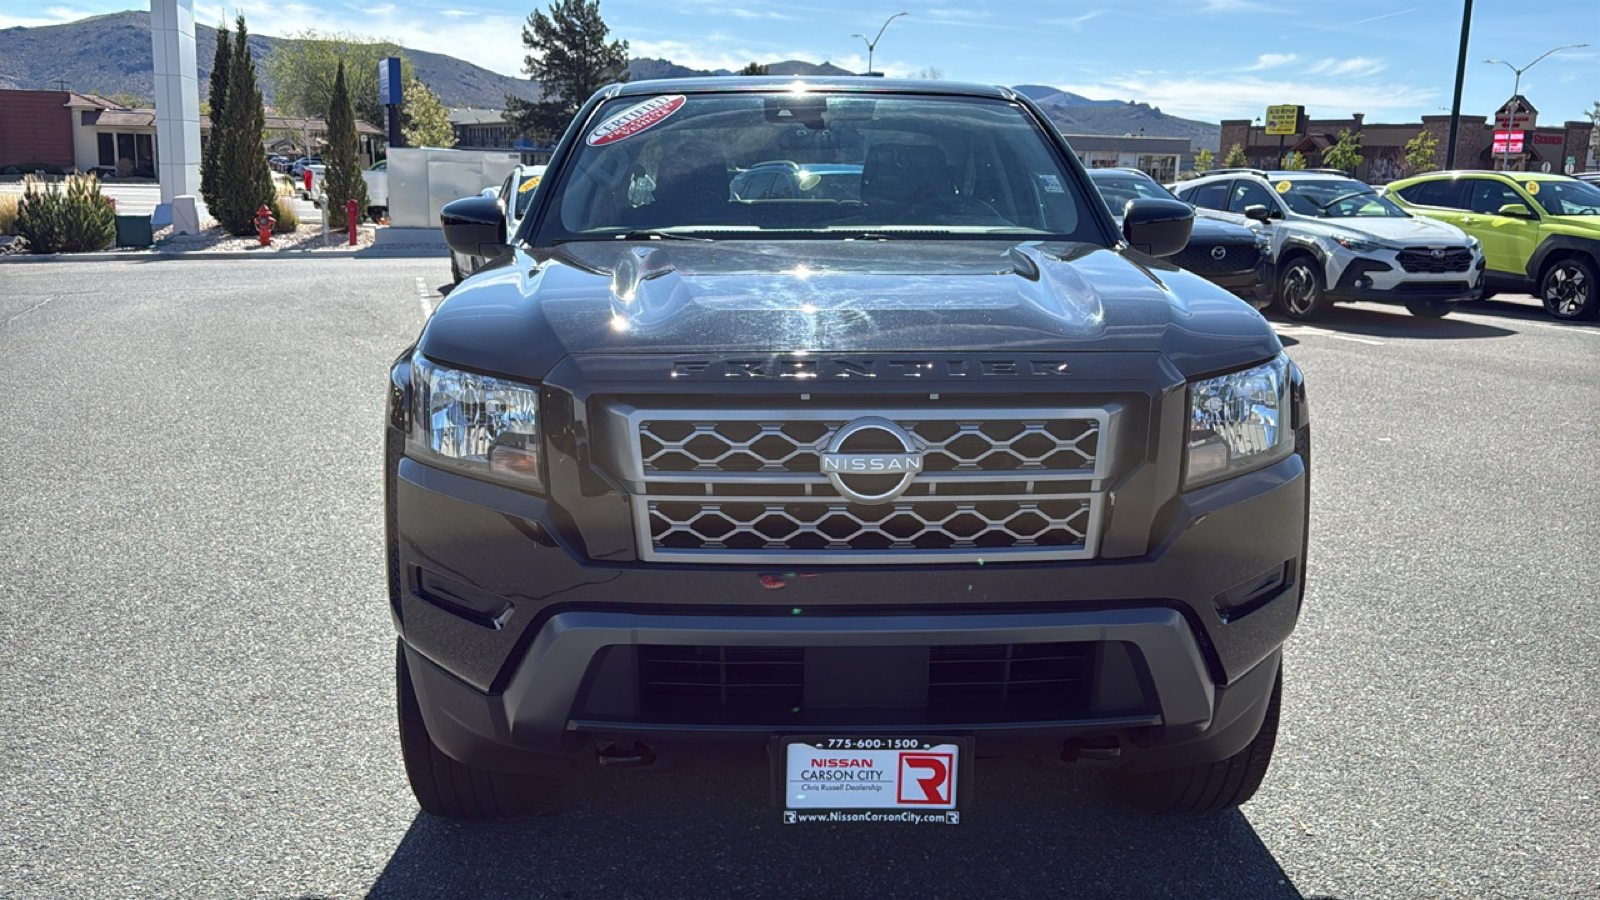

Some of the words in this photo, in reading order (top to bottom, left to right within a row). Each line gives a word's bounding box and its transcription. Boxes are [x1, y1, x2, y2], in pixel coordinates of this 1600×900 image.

[671, 360, 1073, 378] FRONTIER
[824, 457, 920, 470] NISSAN
[828, 739, 919, 749] 775-600-1500
[811, 758, 873, 768] NISSAN
[801, 770, 854, 781] CARSON
[857, 770, 883, 781] CITY
[845, 784, 882, 793] Dealership
[798, 811, 945, 825] www.NissanCarsonCity.com
